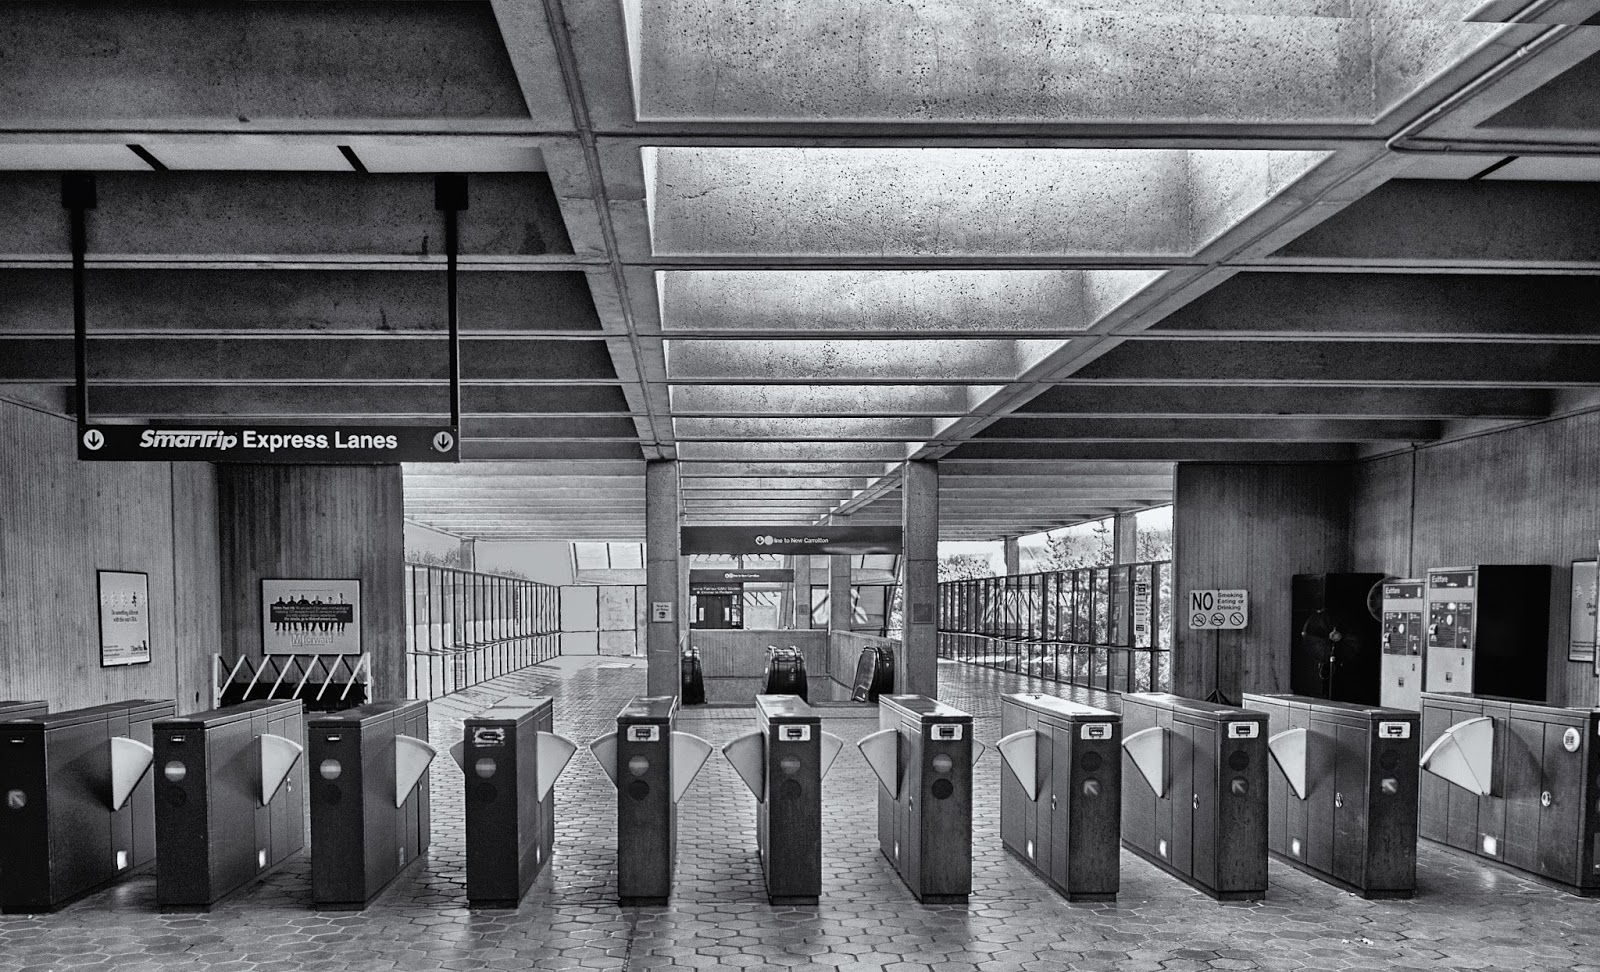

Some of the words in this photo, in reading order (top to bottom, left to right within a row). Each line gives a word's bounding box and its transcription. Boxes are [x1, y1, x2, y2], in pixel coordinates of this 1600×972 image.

[139, 429, 238, 450] SmarTrip
[242, 431, 327, 453] Express
[334, 431, 398, 449] Lanes
[1193, 592, 1213, 611] NO
